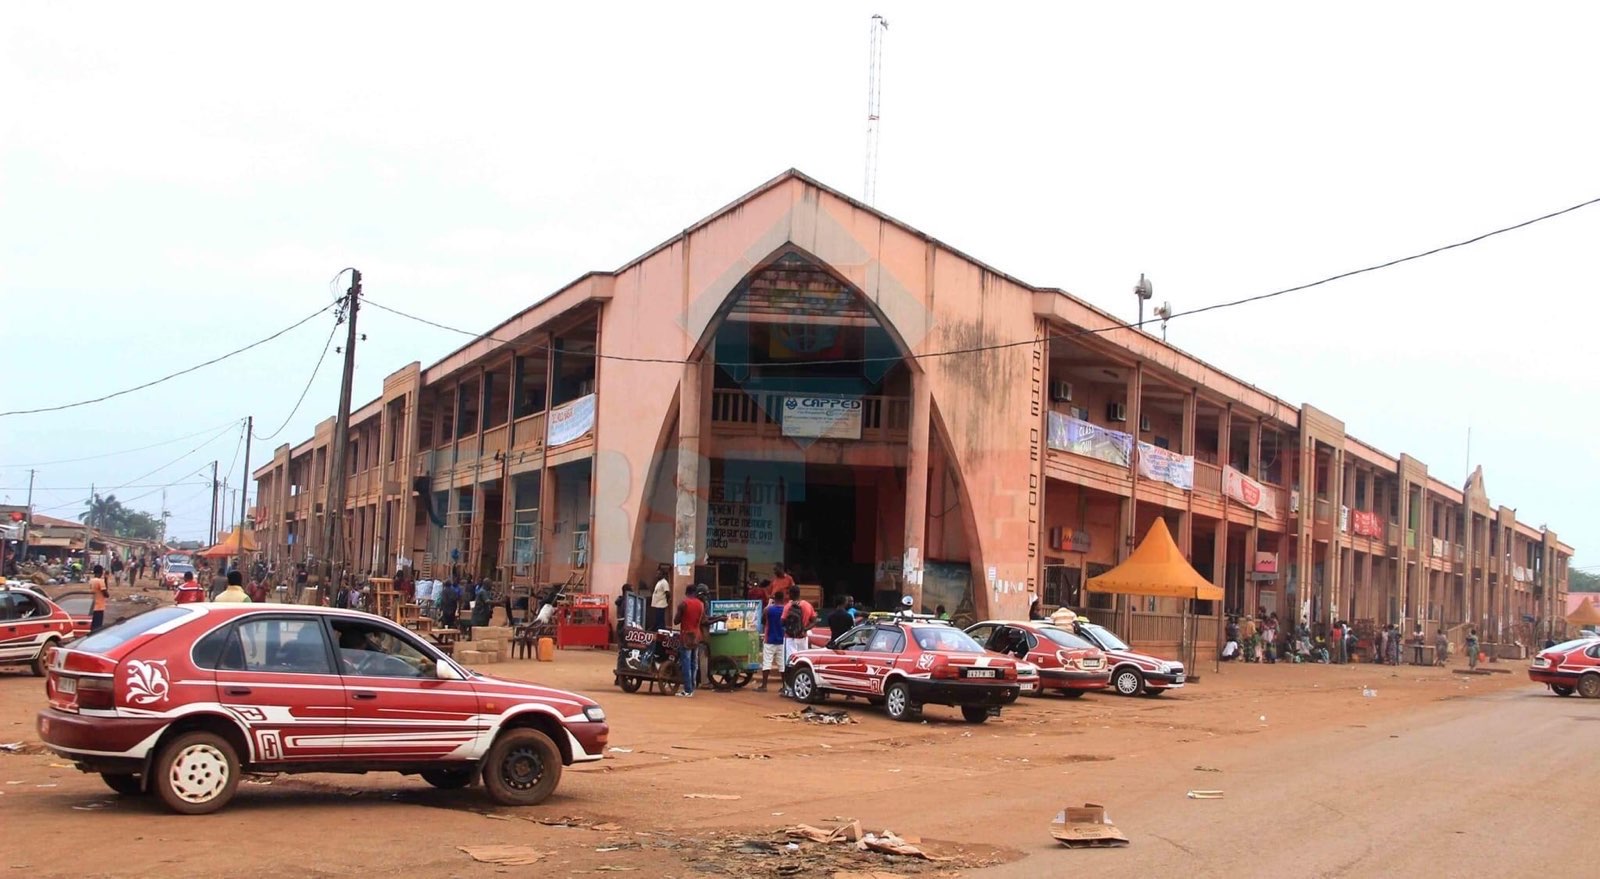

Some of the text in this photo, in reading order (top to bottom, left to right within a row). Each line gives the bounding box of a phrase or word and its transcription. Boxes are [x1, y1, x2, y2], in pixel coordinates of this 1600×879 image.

[801, 398, 861, 409] CAPPED
[1030, 428, 1038, 461] DE
[1026, 474, 1038, 593] DOLISIE
[625, 630, 654, 644] JADU
